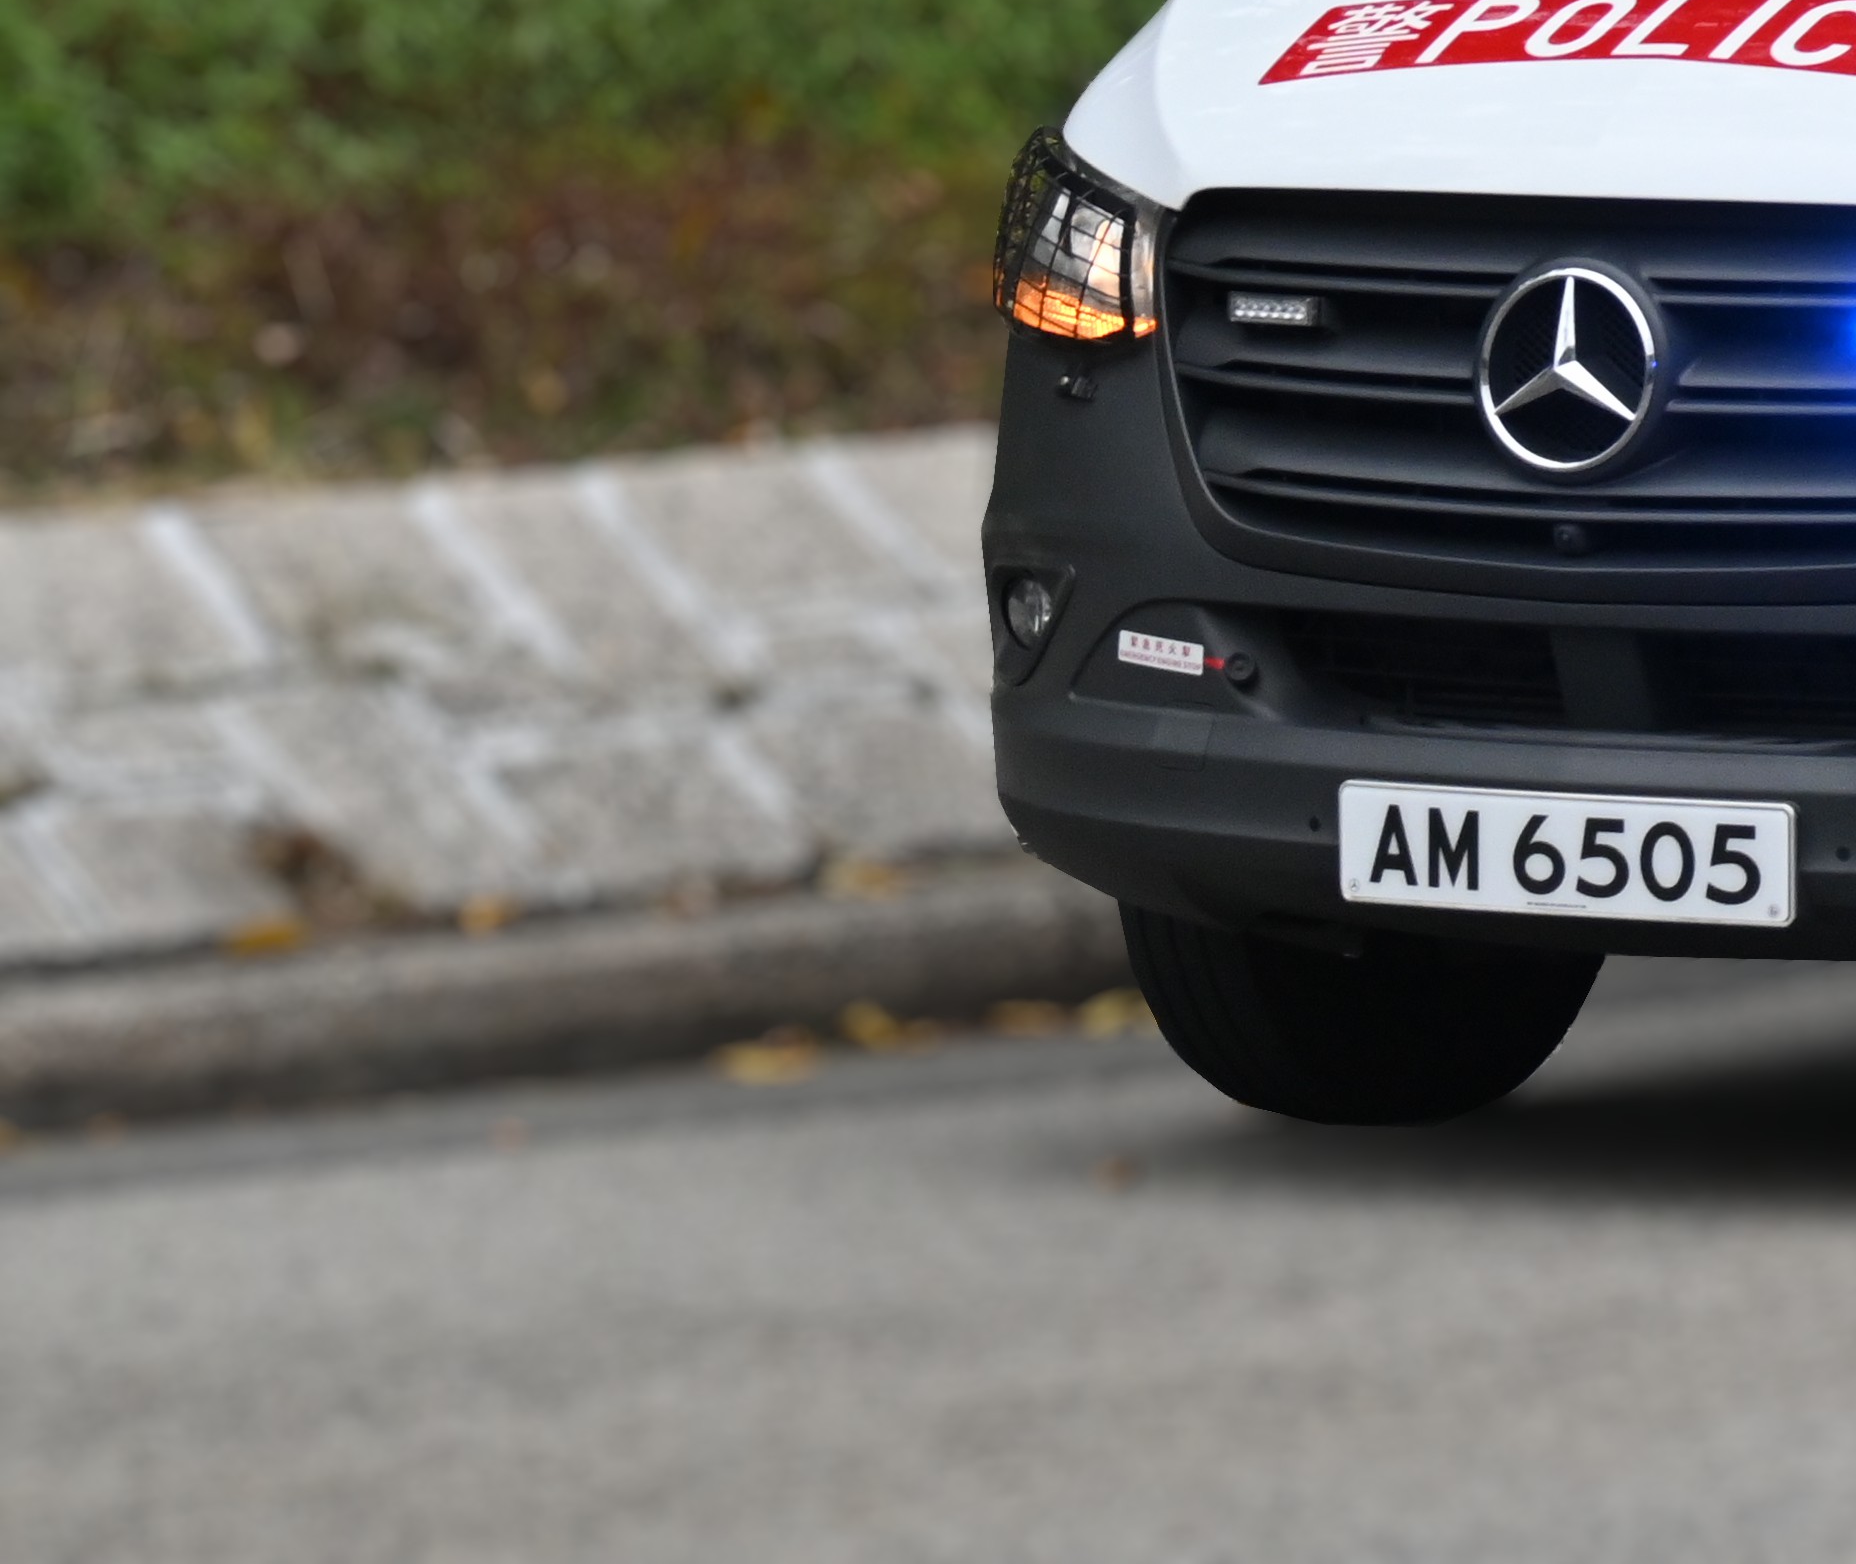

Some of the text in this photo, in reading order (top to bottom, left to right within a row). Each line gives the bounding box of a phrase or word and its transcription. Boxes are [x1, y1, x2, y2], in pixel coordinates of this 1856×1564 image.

[1300, 0, 1455, 76] 警
[1369, 803, 1761, 906] AM 6505
